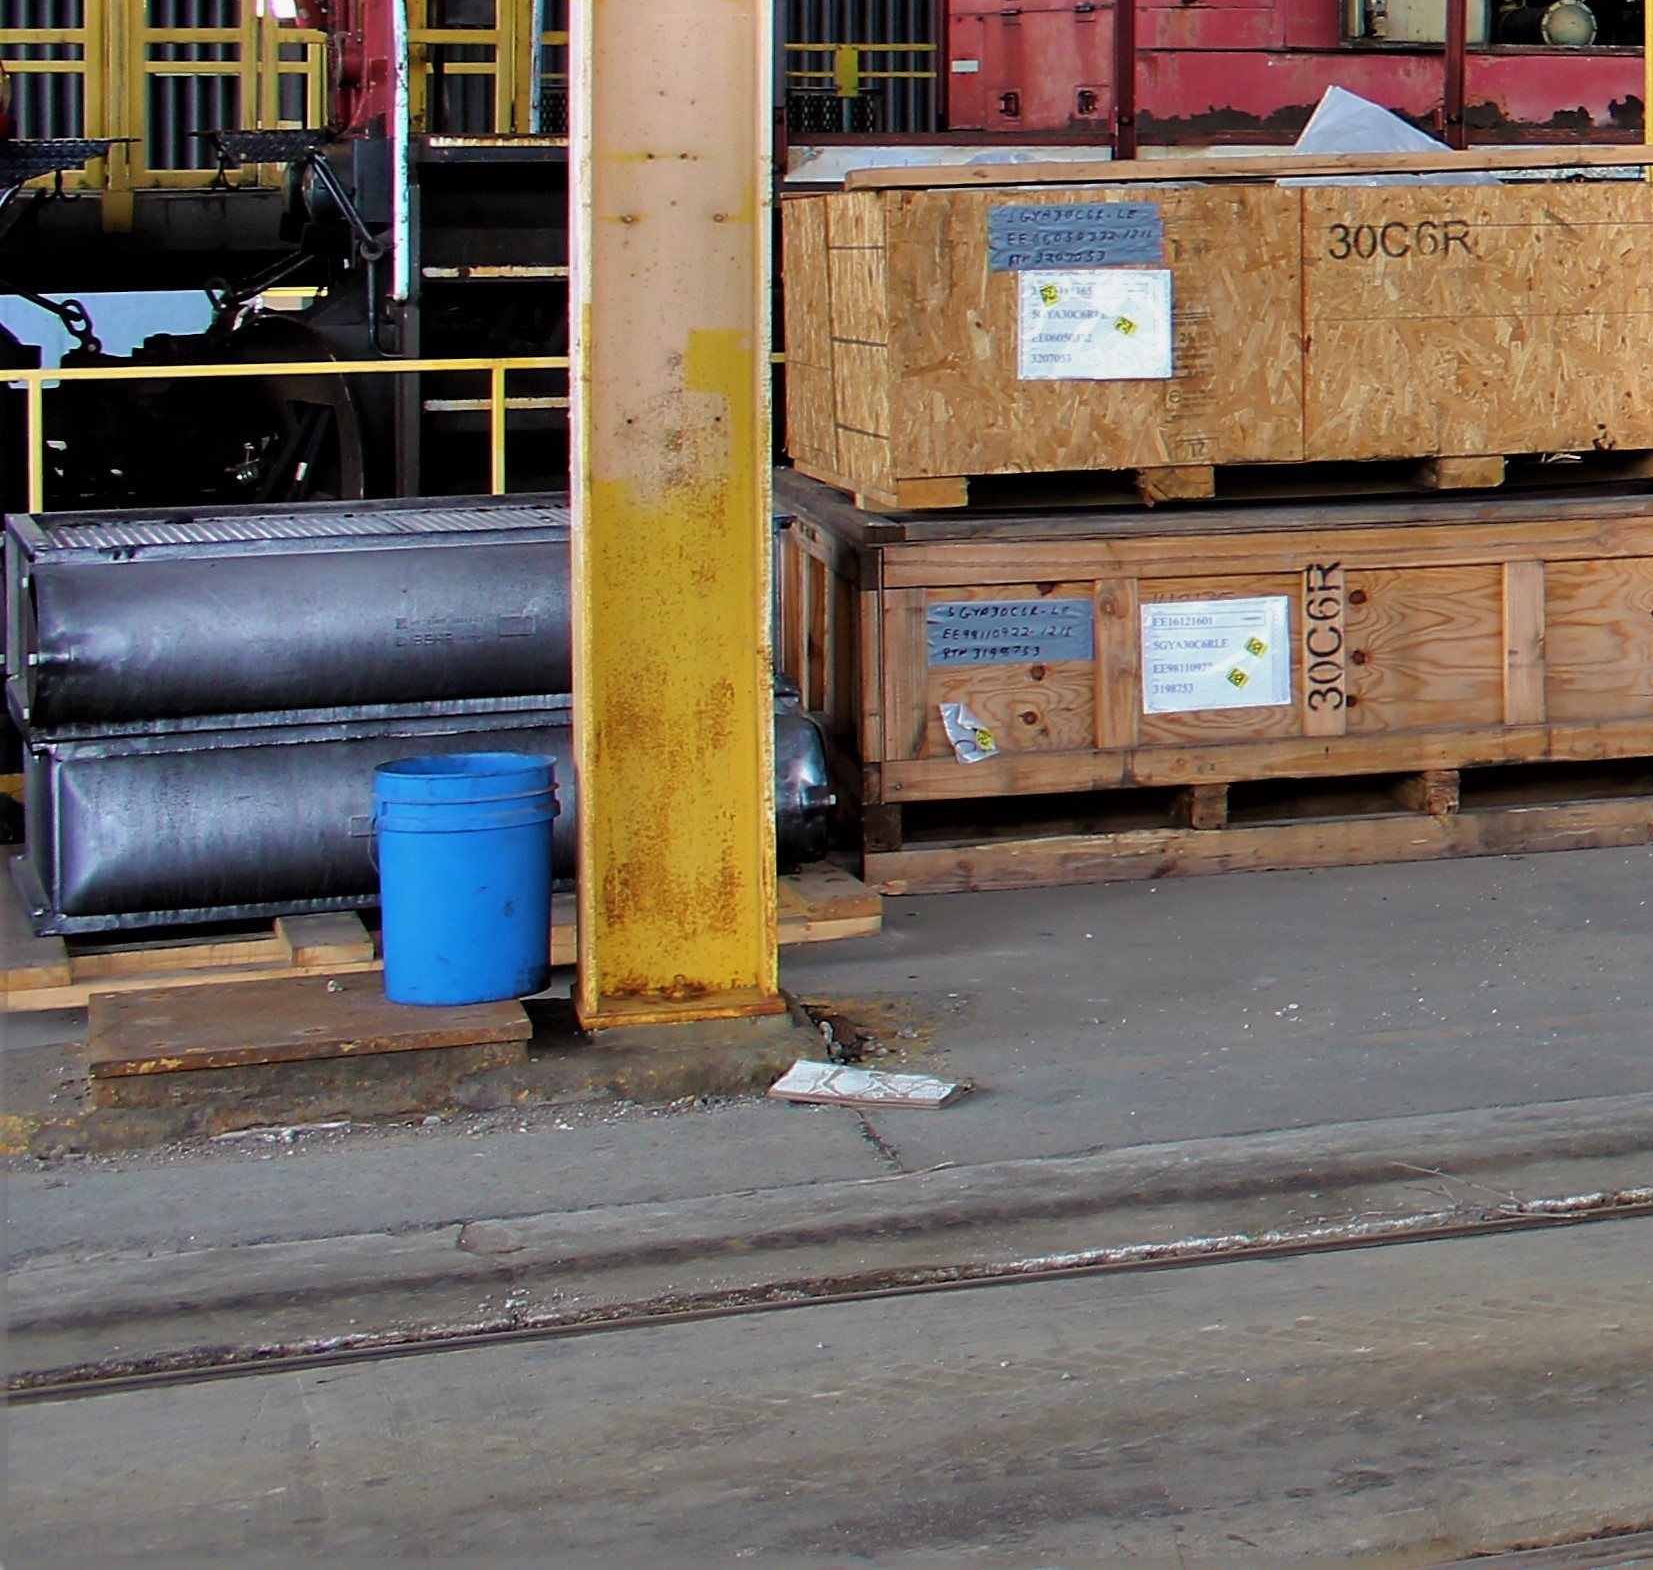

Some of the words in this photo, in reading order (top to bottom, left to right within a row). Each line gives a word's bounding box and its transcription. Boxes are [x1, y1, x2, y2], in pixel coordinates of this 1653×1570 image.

[1328, 218, 1473, 261] 30C6R
[1306, 561, 1344, 712] 30C6R
[1152, 683, 1194, 695] 3198753
